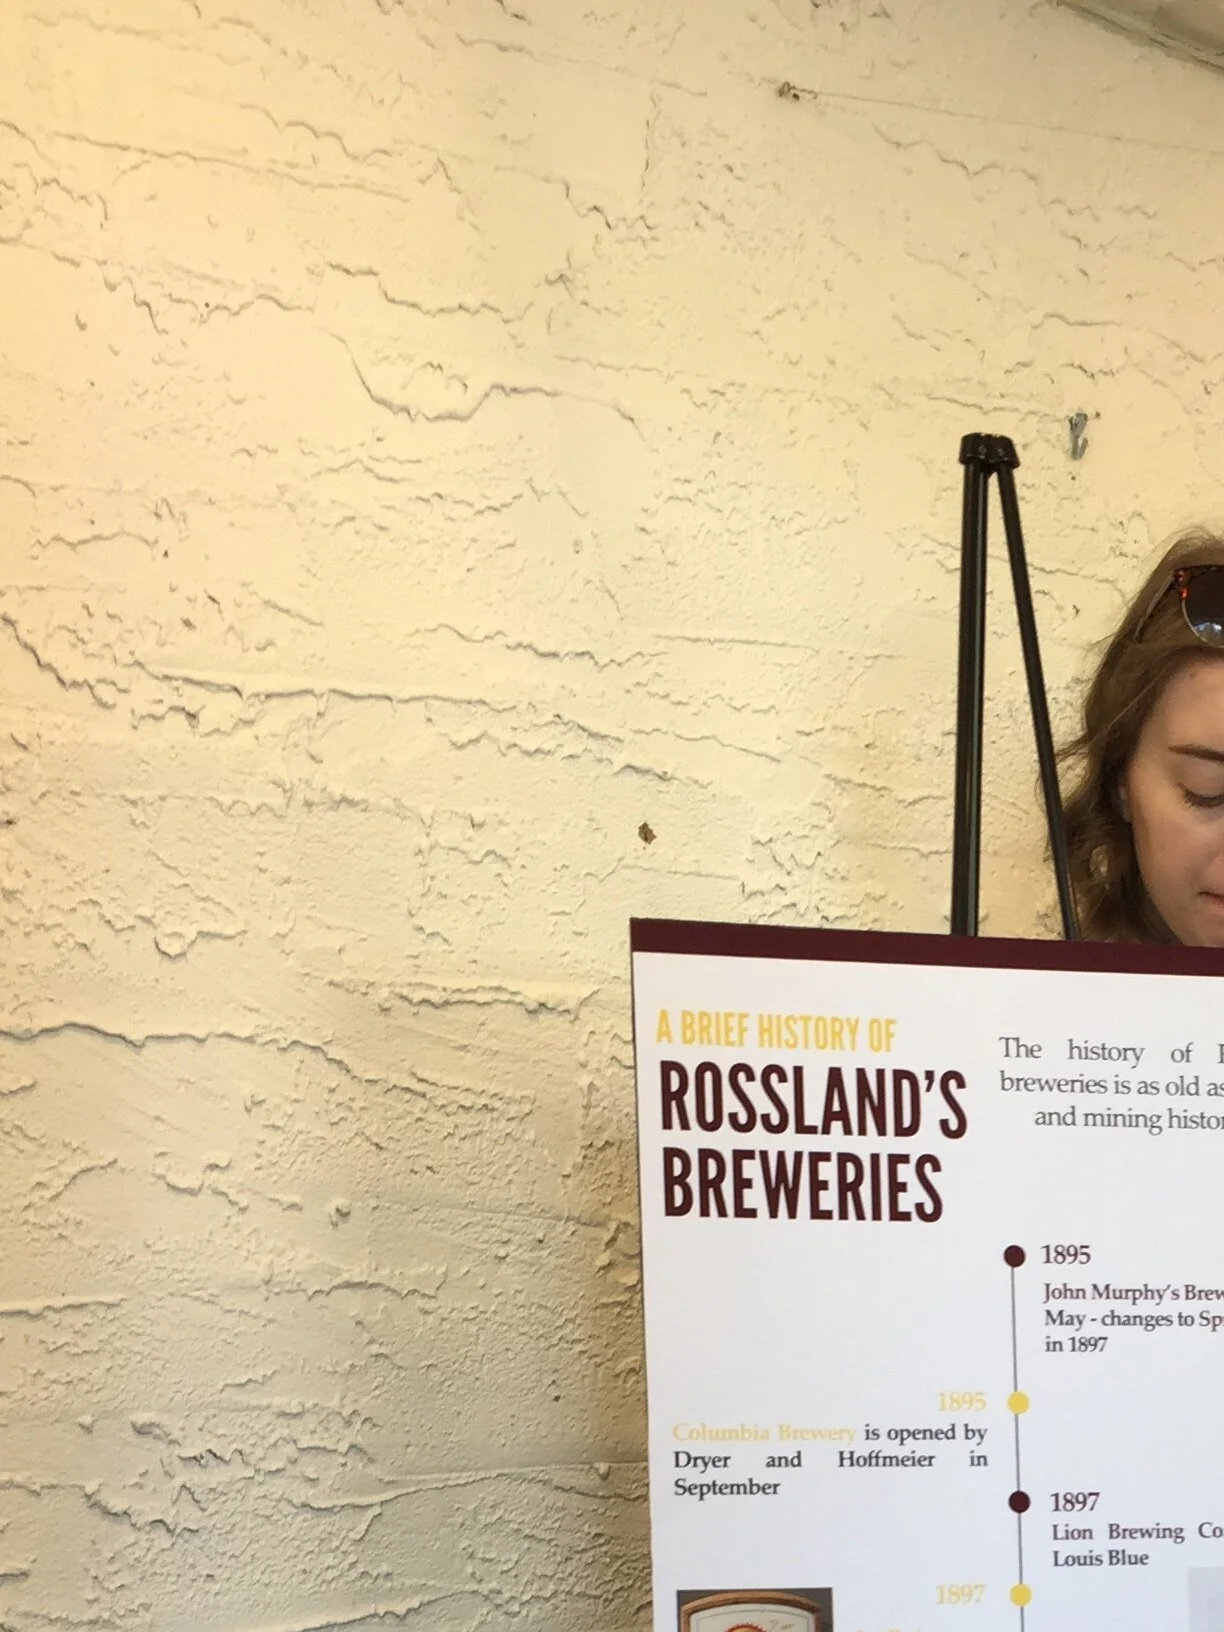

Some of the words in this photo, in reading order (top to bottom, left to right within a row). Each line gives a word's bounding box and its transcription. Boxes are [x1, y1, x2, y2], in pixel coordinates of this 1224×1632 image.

[656, 1009, 672, 1044] A
[680, 1010, 749, 1047] BRIEF
[758, 1013, 860, 1050] HISTORY
[868, 1018, 897, 1052] OF
[998, 1037, 1042, 1059] The
[1068, 1039, 1145, 1069] history
[1171, 1042, 1193, 1063] of
[1000, 1070, 1108, 1094] breweries
[1114, 1074, 1131, 1095] is
[1137, 1081, 1160, 1095] as
[1165, 1075, 1201, 1096] old
[1035, 1105, 1077, 1126] and
[1083, 1107, 1163, 1136] mining
[662, 1147, 943, 1223] BREWERIES
[1041, 1245, 1091, 1264] 1895
[1043, 1283, 1086, 1304] John
[1045, 1336, 1063, 1352] in
[1068, 1336, 1108, 1352] 1897
[939, 1392, 987, 1412] 1895
[1051, 1492, 1100, 1512] 1897
[1052, 1524, 1093, 1540] Lion
[1108, 1523, 1185, 1544] Brewing
[1053, 1550, 1103, 1566] Louis
[1108, 1549, 1149, 1566] Blue
[936, 1584, 985, 1604] 1897
